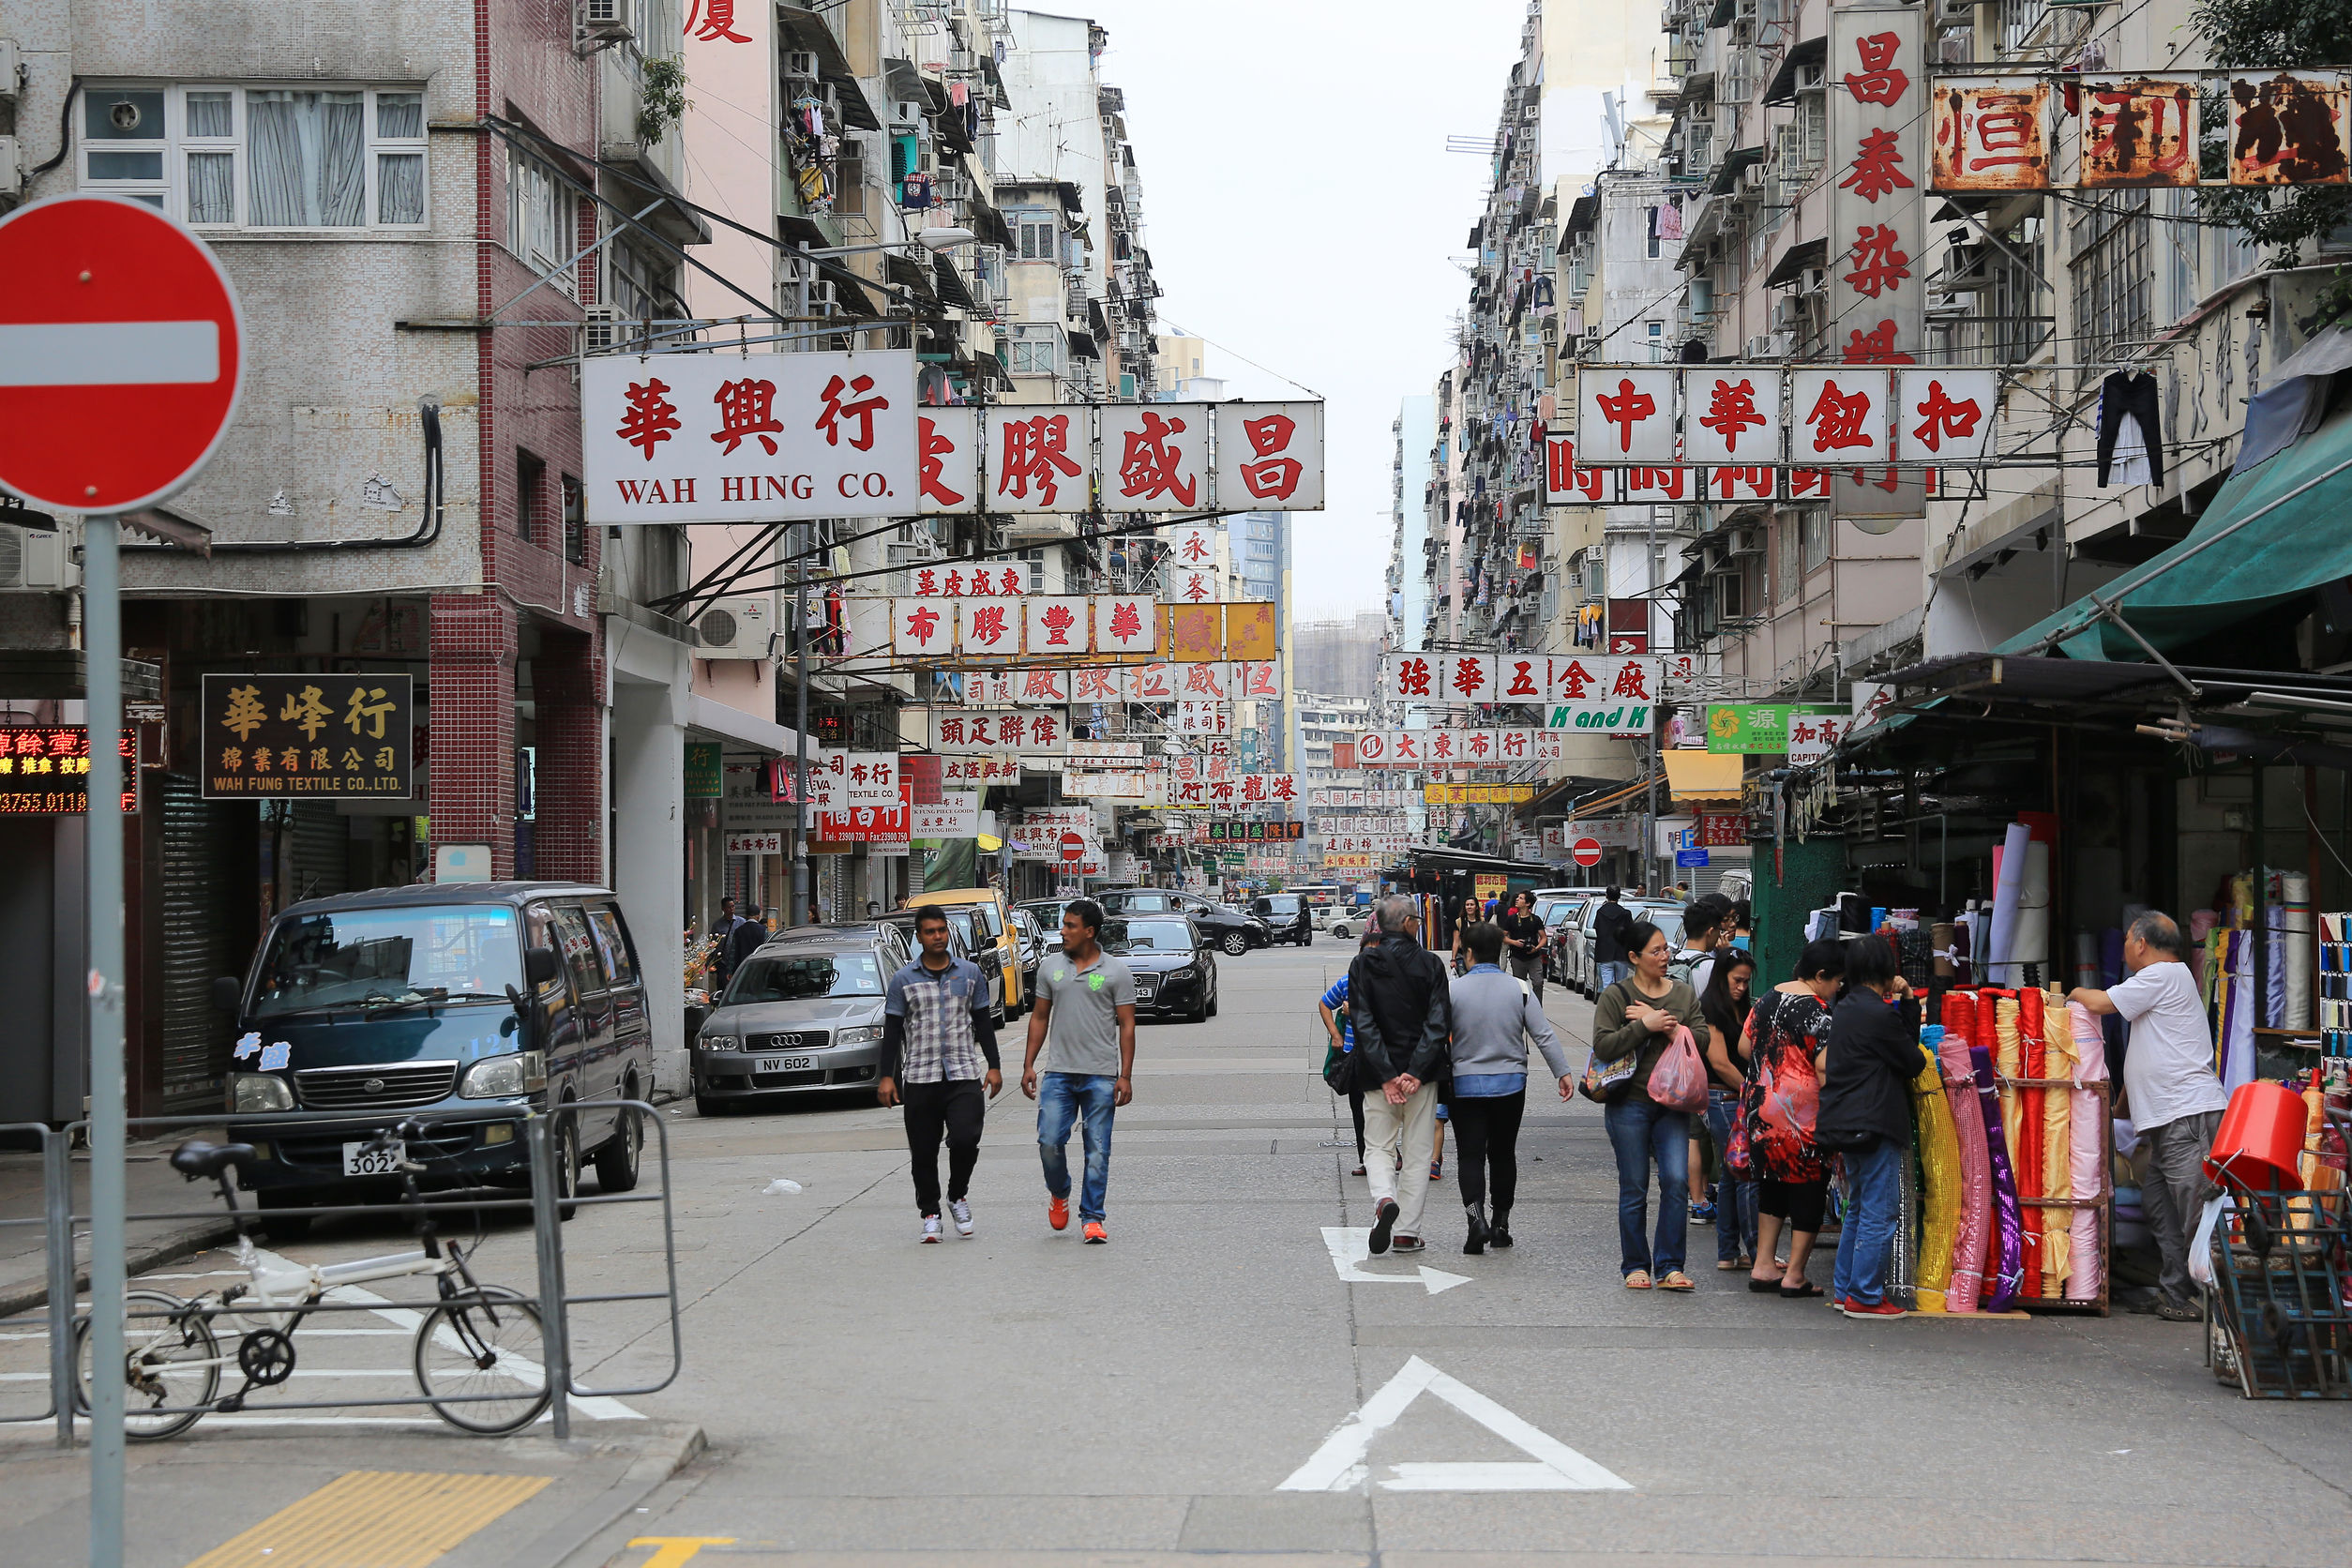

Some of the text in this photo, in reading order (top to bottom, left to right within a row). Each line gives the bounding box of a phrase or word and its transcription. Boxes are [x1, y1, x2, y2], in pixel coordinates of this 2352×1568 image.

[616, 374, 889, 461] 華興行
[1596, 378, 1982, 454] 中華鈕扣
[616, 473, 894, 505] WAH HING CO.
[1397, 656, 1651, 701] 強華五金廠
[221, 684, 397, 743] 華峰行
[1548, 706, 1650, 729] K and K
[220, 746, 395, 773] 棉業有限公司
[1395, 732, 1528, 760] 大東布行
[214, 776, 244, 791] WAH
[249, 776, 283, 791] FUNG
[288, 776, 341, 791] TEXTILE
[850, 762, 893, 787] 布行
[882, 790, 895, 798] CO.
[1033, 842, 1055, 851] HING
[763, 1057, 810, 1070] NV 602
